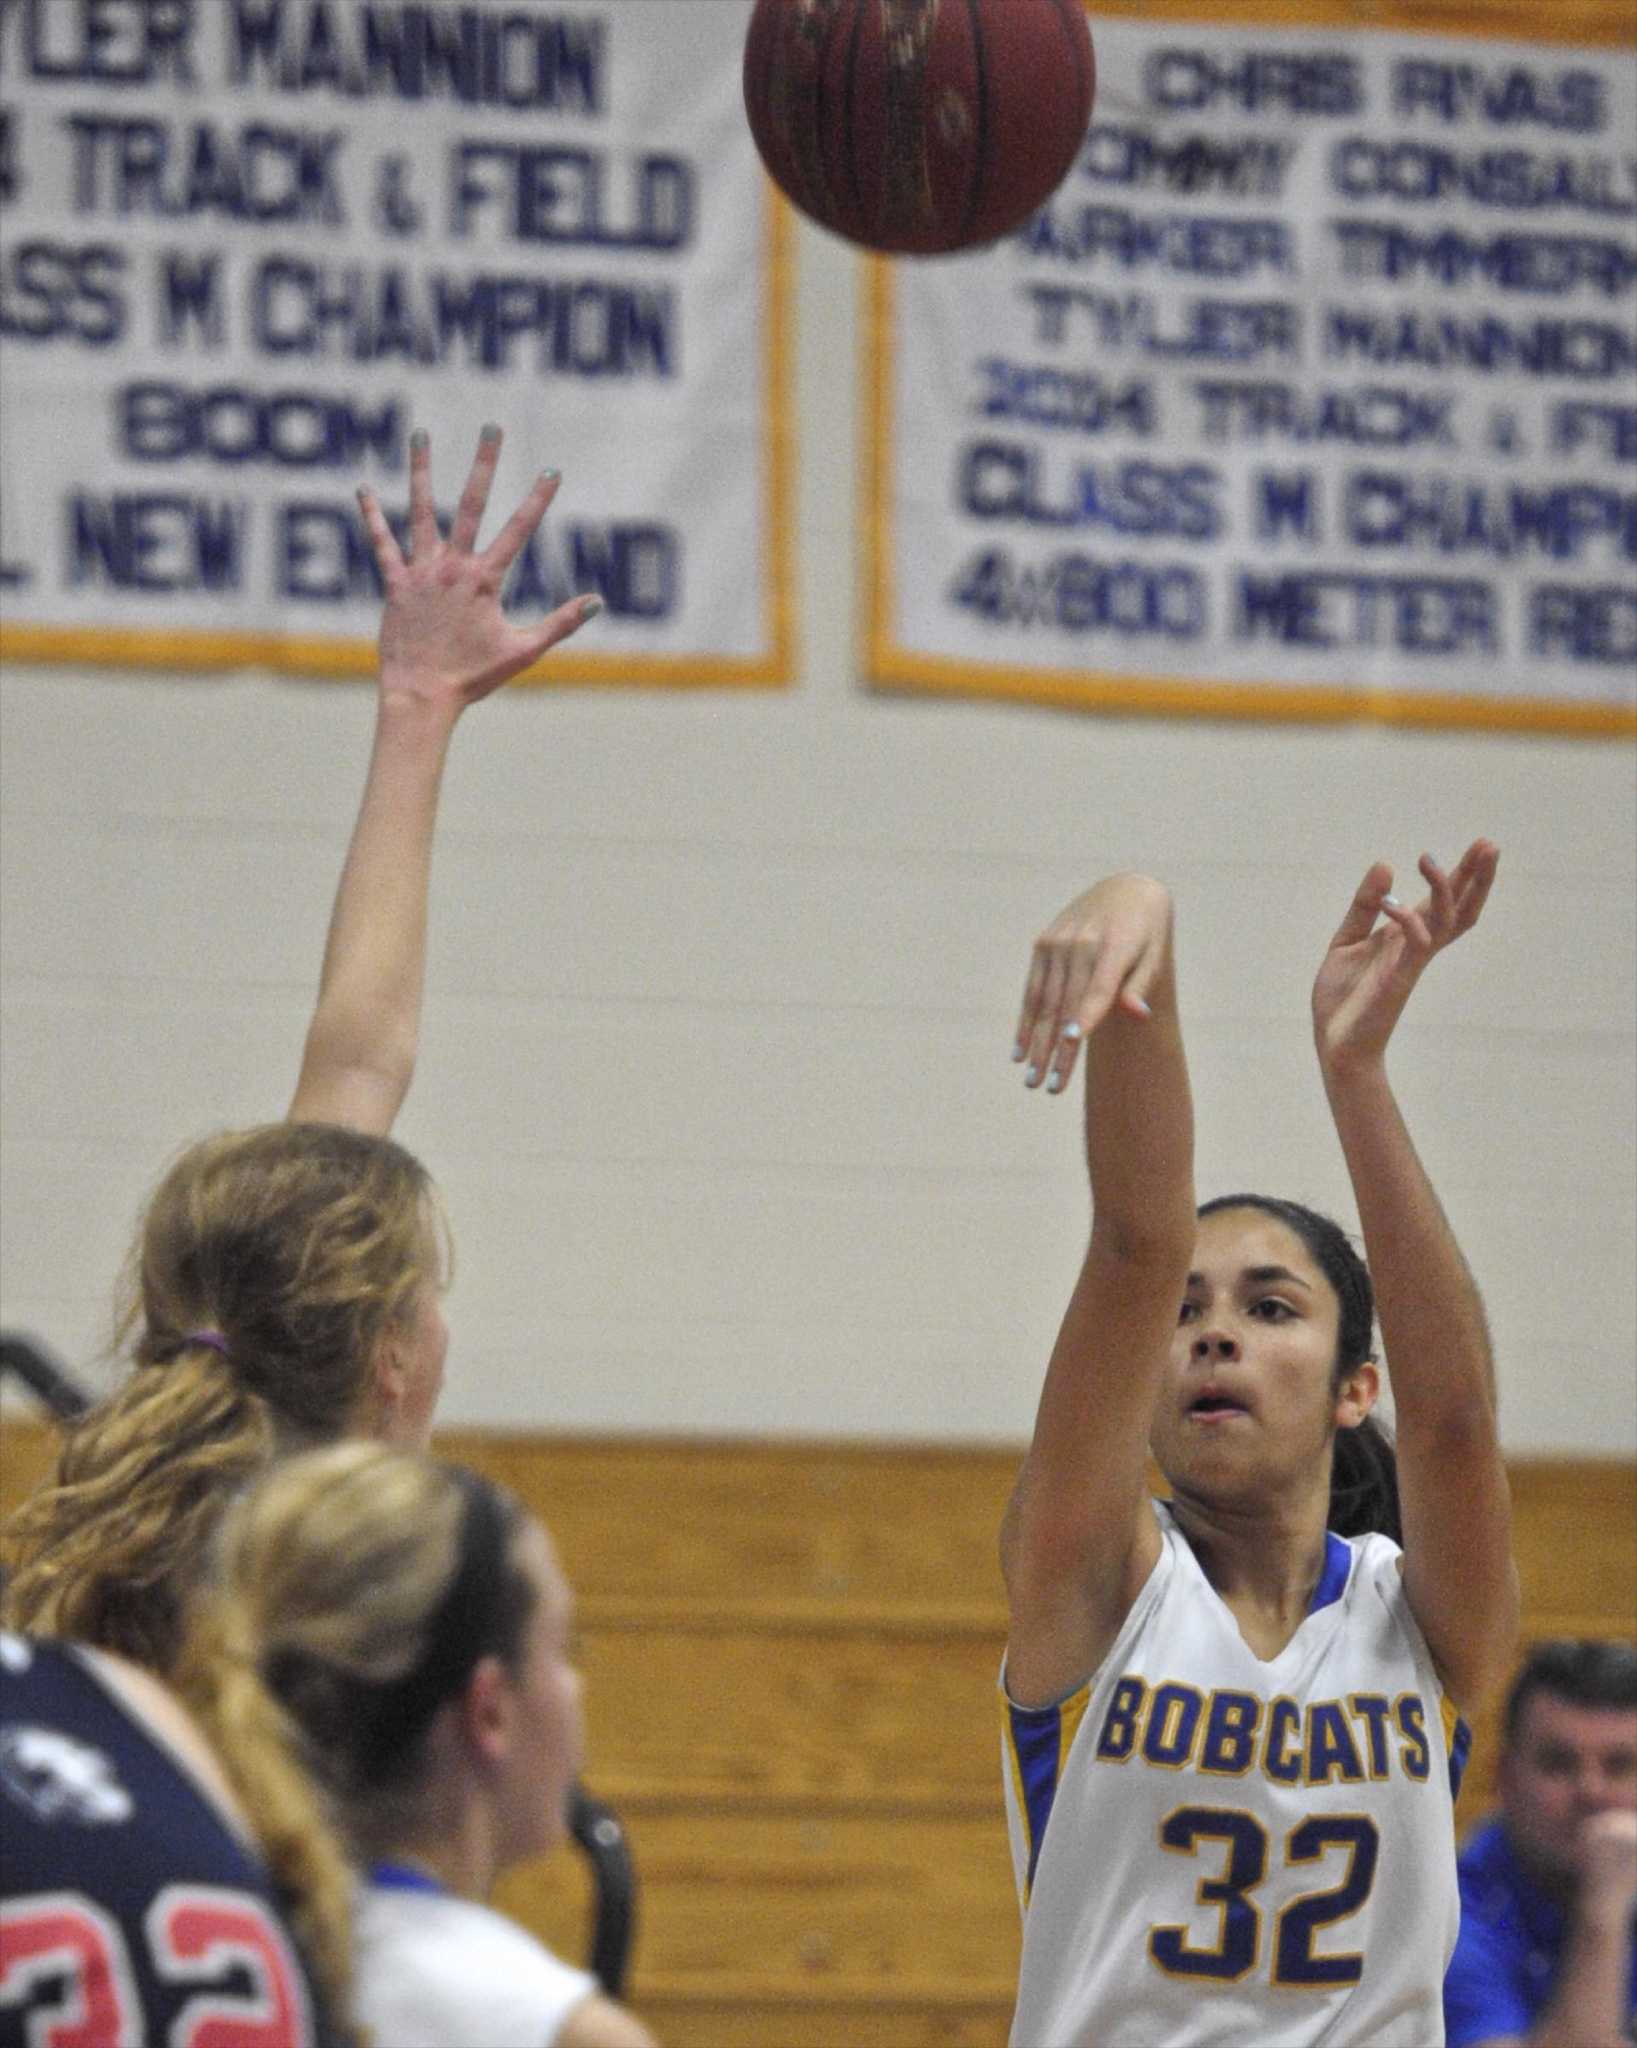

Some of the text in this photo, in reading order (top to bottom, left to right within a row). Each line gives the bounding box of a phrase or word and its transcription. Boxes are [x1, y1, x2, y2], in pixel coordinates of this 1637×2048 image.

[232, 0, 606, 116] MANNION
[66, 113, 346, 228] TRACK
[452, 140, 696, 253] FIELD
[1080, 122, 1288, 194] OMMY
[1023, 202, 1293, 278] ARKER
[0, 241, 676, 378] SS M CHAMPION
[1193, 376, 1450, 450] TRACK
[958, 440, 1220, 540] CLASS
[69, 490, 682, 622] NEW ENAND
[1233, 566, 1500, 655] METER
[1096, 1674, 1430, 1787] BOBCATS
[1148, 1806, 1379, 1990] 32
